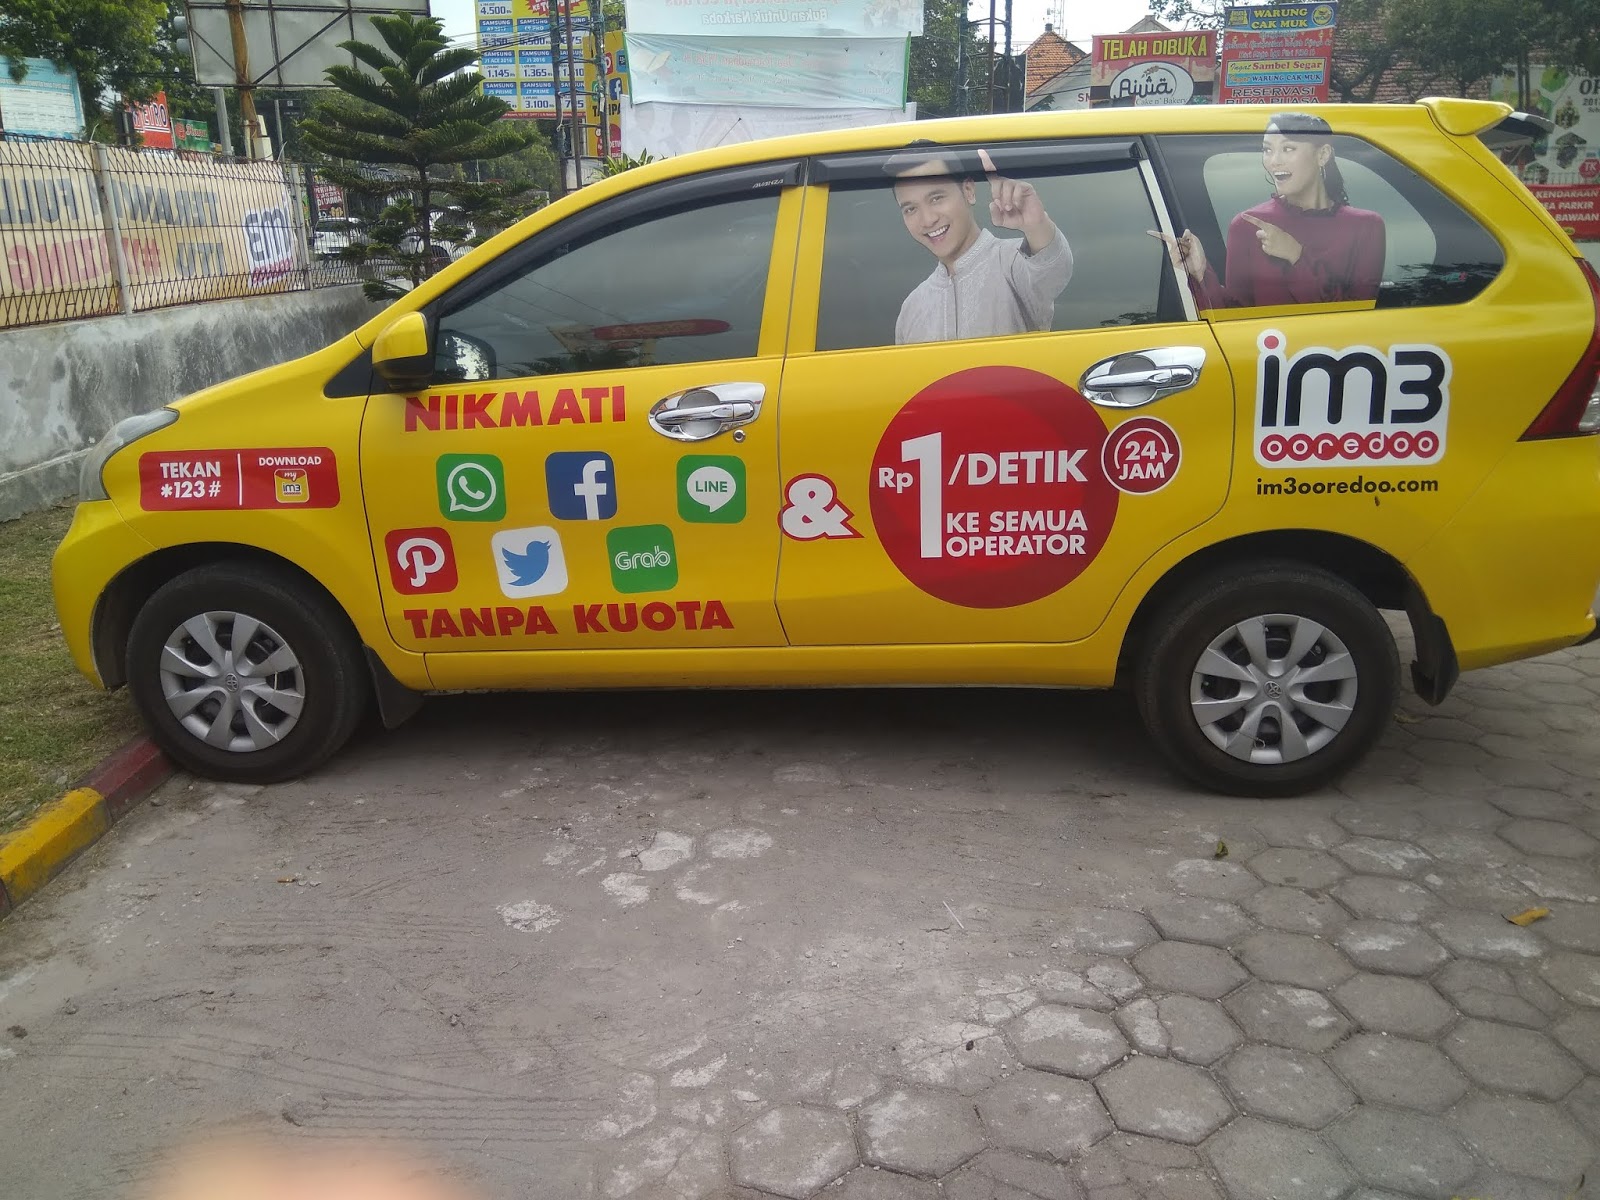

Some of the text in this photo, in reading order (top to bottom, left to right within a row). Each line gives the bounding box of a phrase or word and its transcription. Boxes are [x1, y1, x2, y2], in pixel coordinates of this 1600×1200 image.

[1253, 8, 1308, 18] WARUNG
[1251, 19, 1308, 29] CAK MUK
[1102, 39, 1148, 61] TELAH
[1153, 35, 1207, 57] DIBUKA
[1252, 62, 1290, 71] Sambel
[1292, 61, 1323, 70] Segar
[487, 69, 510, 78] 1.145
[523, 69, 547, 77] 1.365
[1232, 86, 1316, 98] RESERVASI
[525, 100, 549, 109] 3.100
[1584, 162, 1597, 171] TK
[752, 178, 784, 189] AVANZA
[1535, 189, 1600, 199] KENDARAAN
[1558, 201, 1594, 210] PARKIR
[1555, 213, 1600, 221] BAWAAN
[405, 385, 626, 432] NIKMATI
[1124, 440, 1158, 461] 24
[1261, 431, 1438, 461] ooredoo
[258, 456, 322, 467] DOWNLOAD
[160, 461, 221, 478] TEKAN
[1117, 462, 1165, 481] JAM
[284, 471, 297, 482] my
[878, 467, 913, 494] Rp
[694, 480, 728, 493] LINE
[1256, 475, 1439, 496] im3ooredoo.com
[901, 431, 943, 559] 1
[946, 509, 1088, 534] KE SEMUA
[945, 534, 1086, 558] OPERATOR
[614, 545, 671, 572] Grab
[403, 600, 735, 639] TANPA KUOTA
